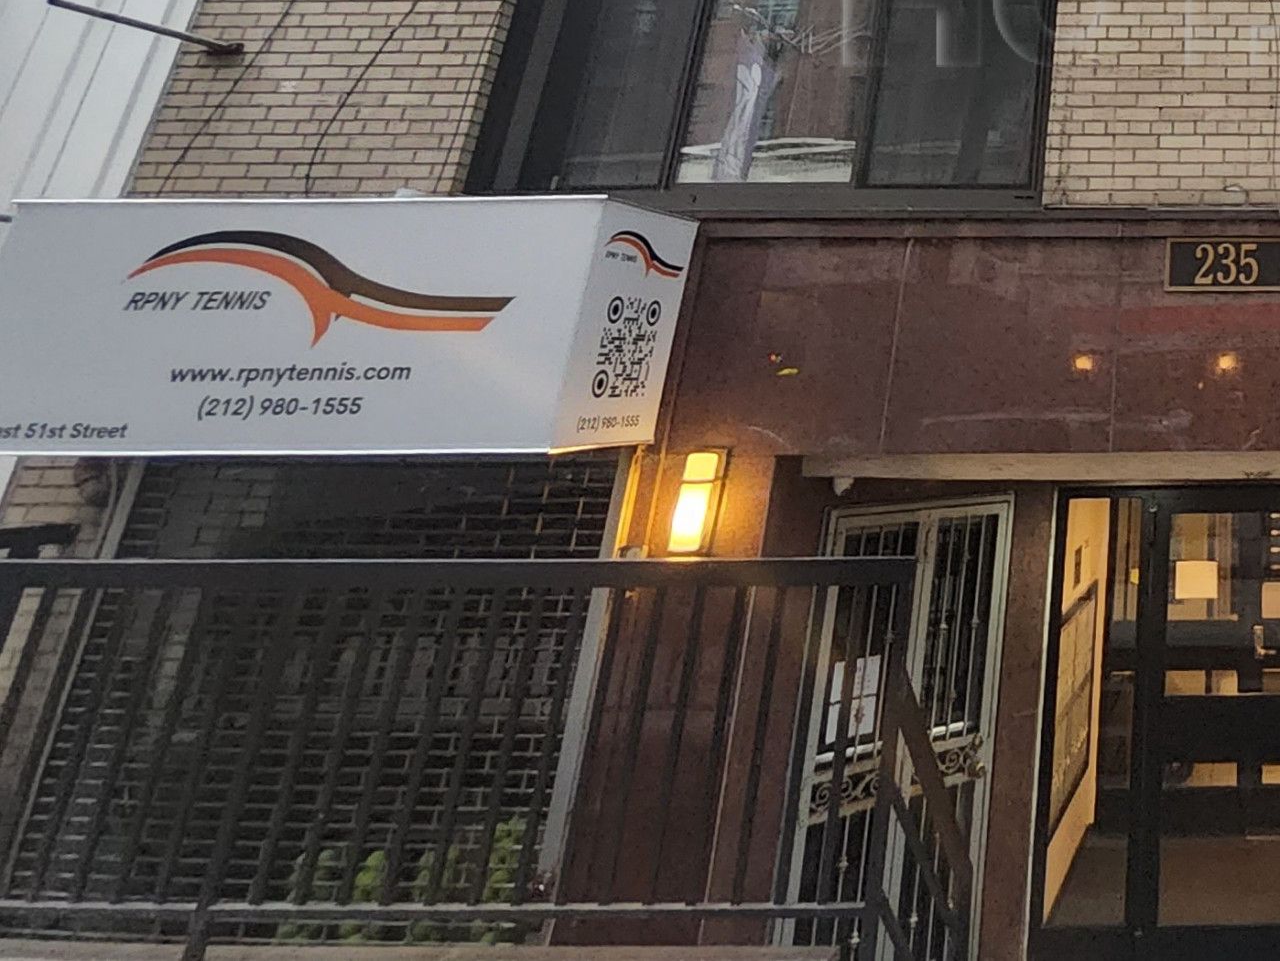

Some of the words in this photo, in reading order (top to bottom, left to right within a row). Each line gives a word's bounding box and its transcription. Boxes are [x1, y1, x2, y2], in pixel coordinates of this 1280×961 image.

[1194, 243, 1259, 285] 235
[123, 291, 189, 311] RPNY
[191, 291, 271, 310] TENNIS
[170, 362, 411, 387] www.rpnytennis.com
[197, 395, 255, 421] (212)
[259, 397, 363, 416] 980-1555
[24, 424, 66, 438] 51st
[70, 423, 128, 438] Street
